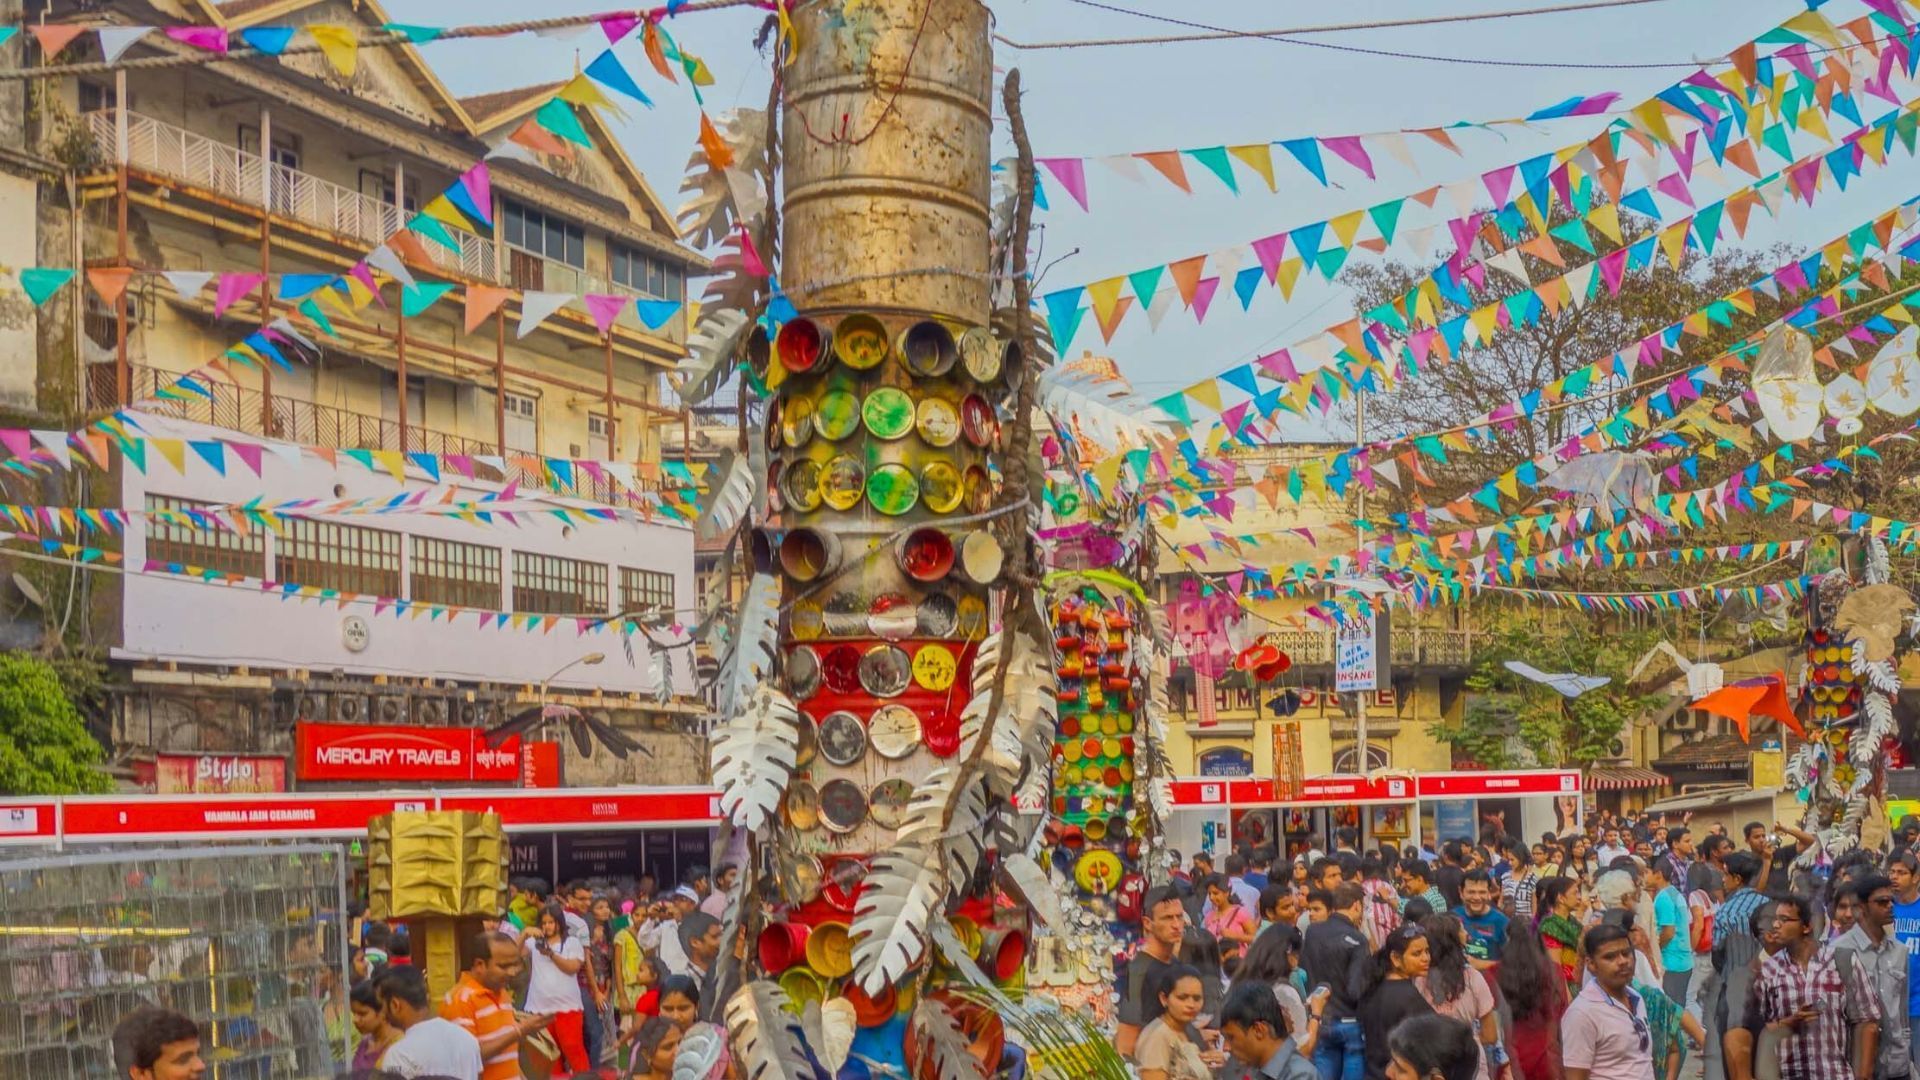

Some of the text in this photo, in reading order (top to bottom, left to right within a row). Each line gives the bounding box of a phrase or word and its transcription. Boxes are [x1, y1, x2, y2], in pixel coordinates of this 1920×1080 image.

[1345, 644, 1362, 657] OUR
[1340, 651, 1370, 669] PRICES
[316, 747, 461, 766] MERCURY TRAVELS
[199, 756, 252, 785] Stylo
[204, 810, 248, 823] VANMALA
[249, 810, 269, 822] JAIN
[269, 808, 316, 822] CERAMICS
